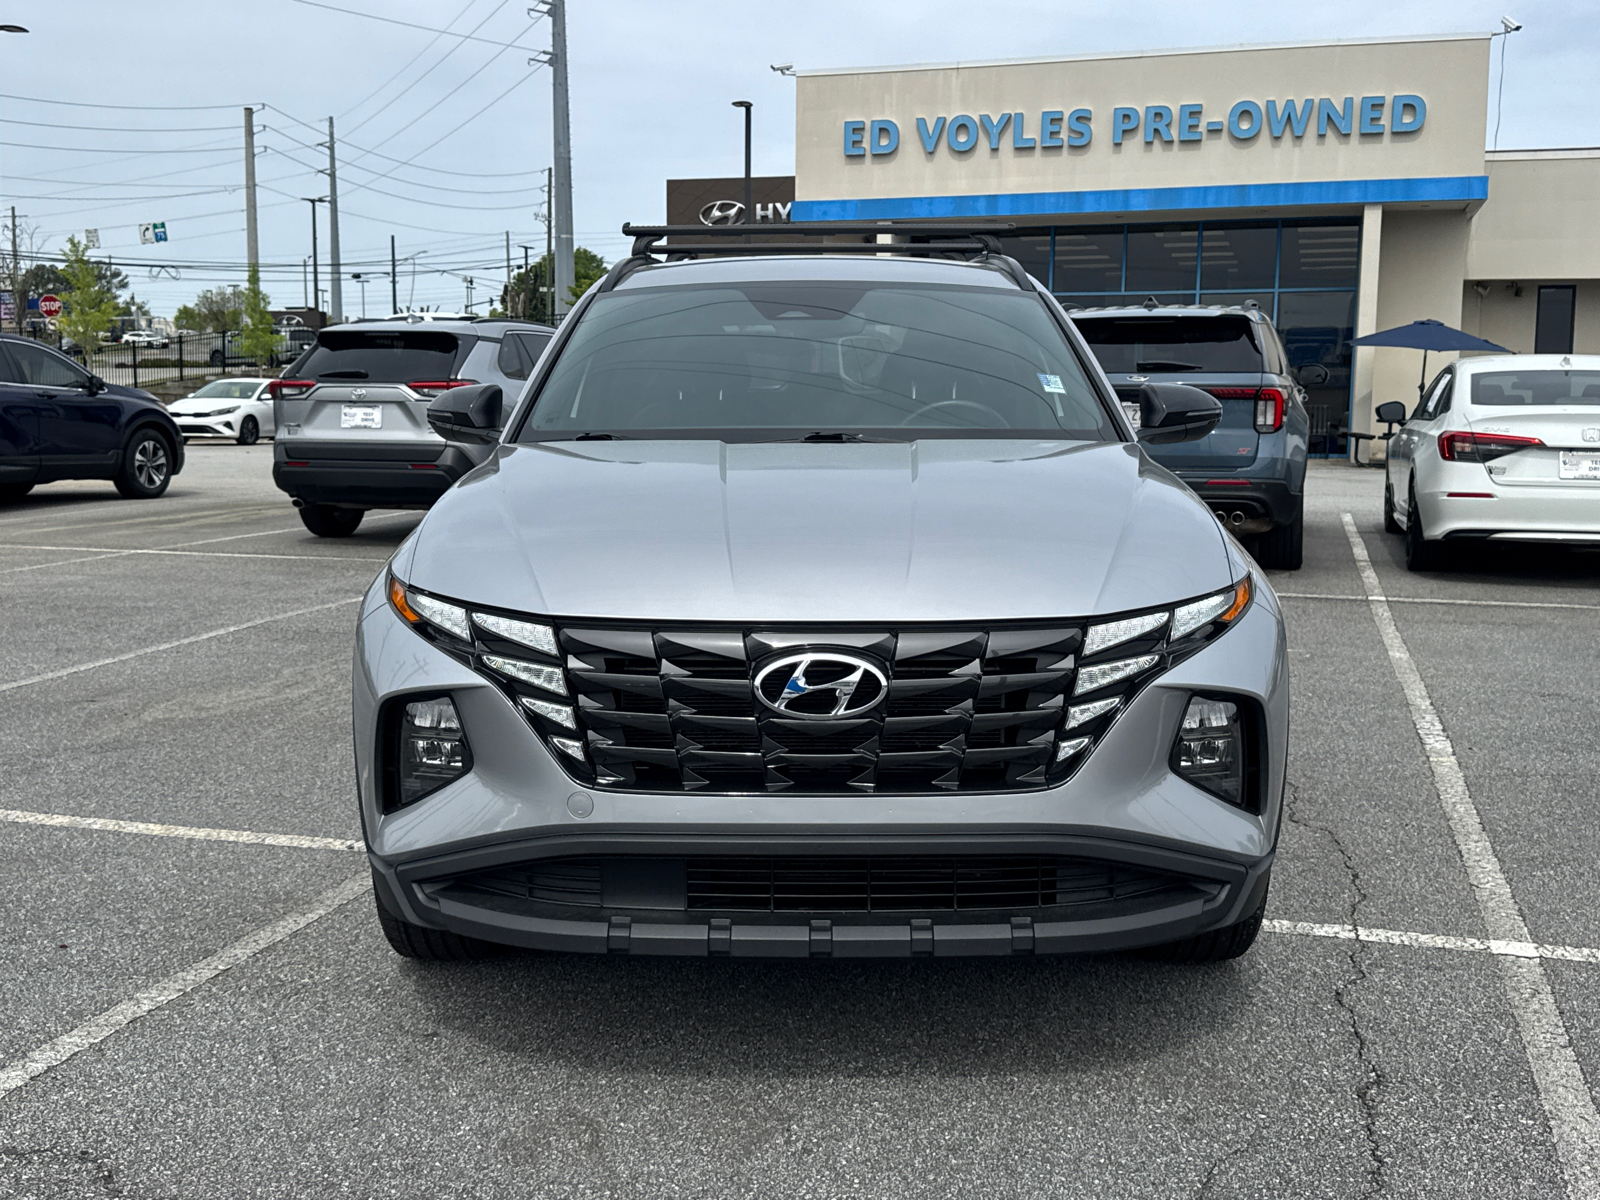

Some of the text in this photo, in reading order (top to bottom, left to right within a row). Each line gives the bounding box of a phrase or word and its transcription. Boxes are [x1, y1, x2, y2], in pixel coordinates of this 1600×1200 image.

[843, 94, 1427, 156] ED VOYLES PRE-OWNED
[41, 301, 61, 312] STOP
